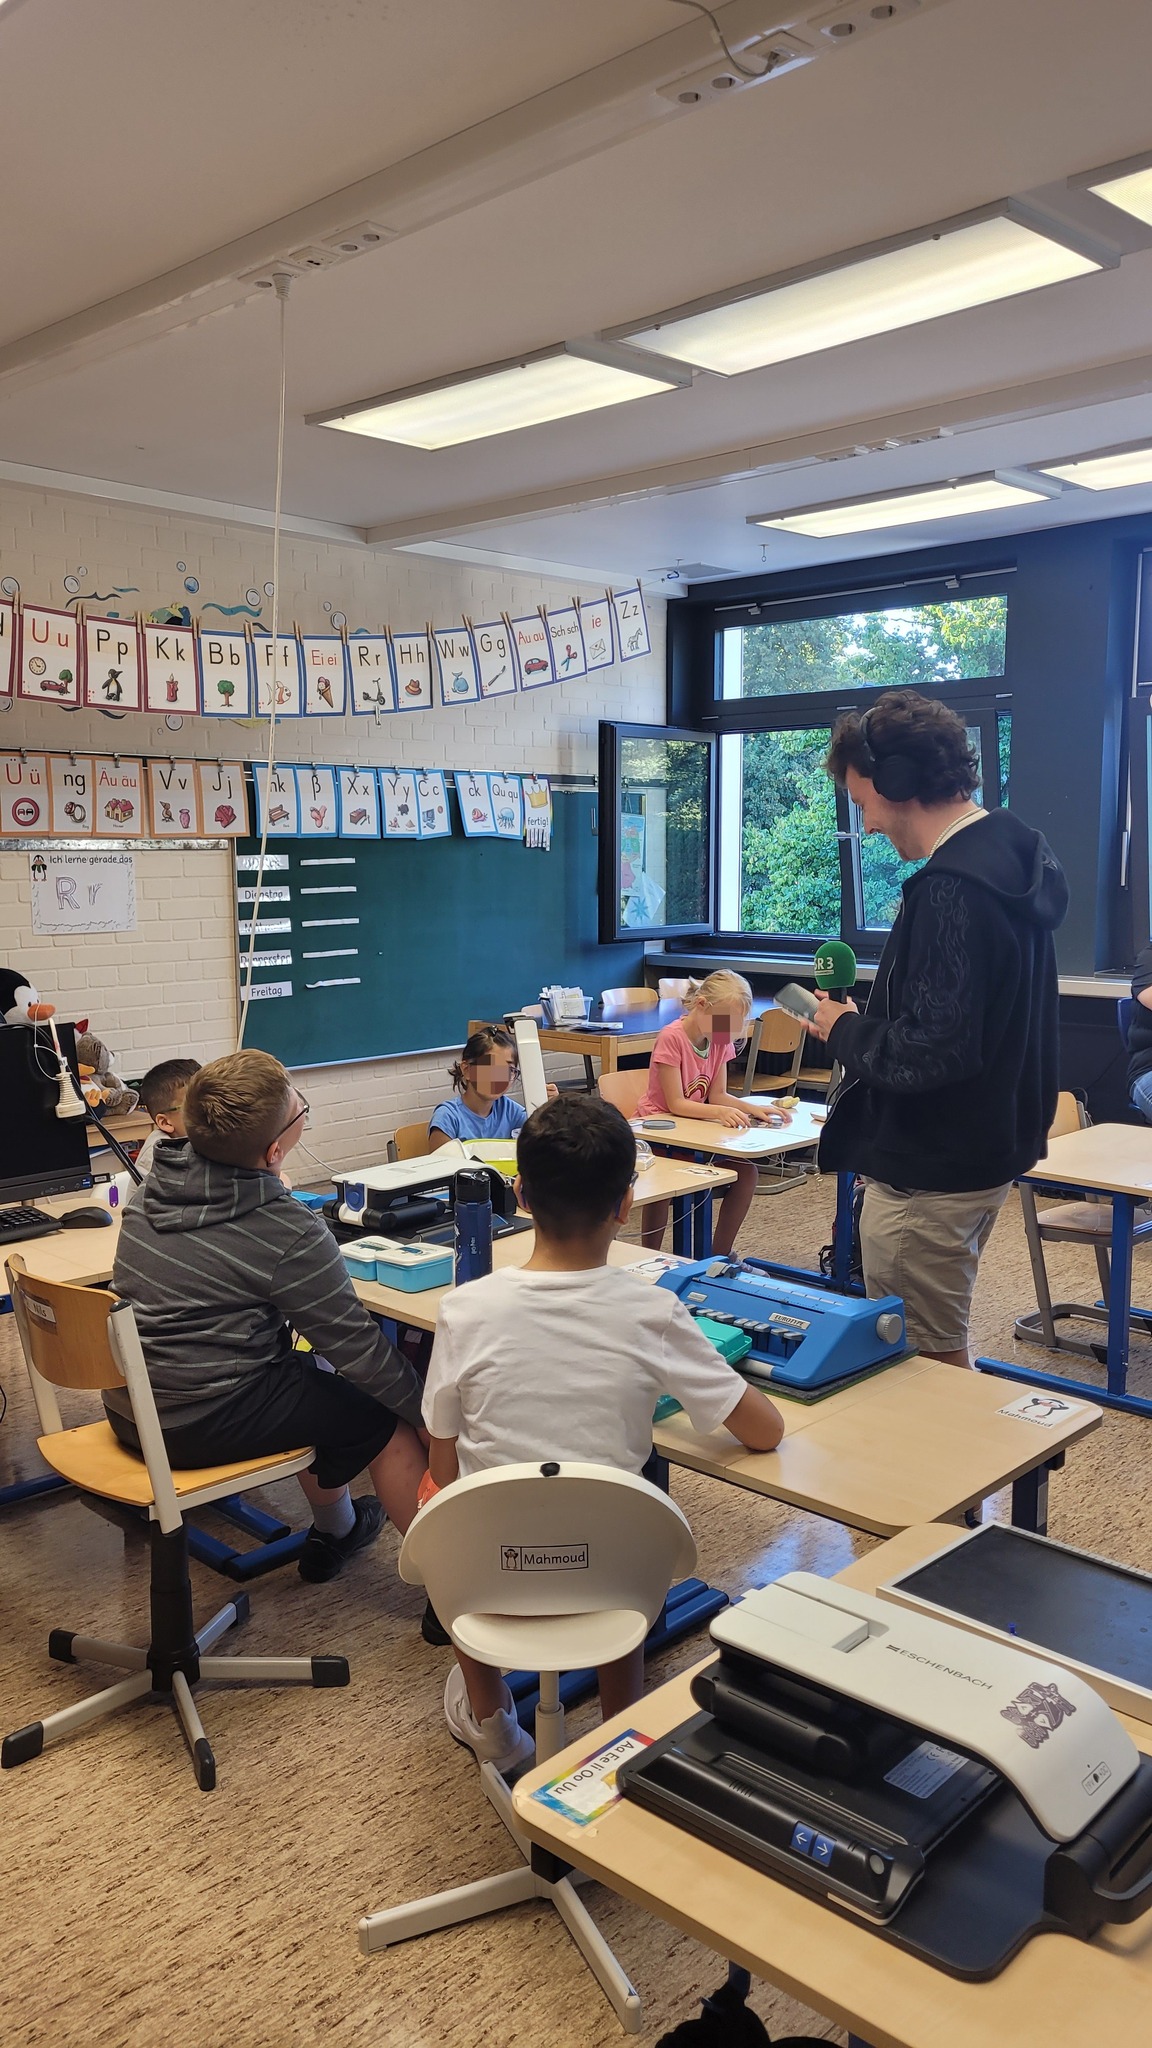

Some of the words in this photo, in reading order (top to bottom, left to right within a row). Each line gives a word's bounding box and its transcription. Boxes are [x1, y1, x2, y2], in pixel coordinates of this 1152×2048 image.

[591, 615, 602, 629] ie
[518, 631, 531, 645] Au
[534, 632, 545, 641] au
[551, 624, 566, 638] Sch
[311, 650, 324, 665] Ei
[99, 767, 118, 786] Äu
[121, 775, 137, 788] äu
[63, 774, 85, 796] ng
[468, 781, 481, 797] ck
[492, 784, 505, 797] Qu
[508, 792, 519, 803] qu
[527, 817, 549, 827] fertig!
[49, 855, 63, 864] Ich
[65, 855, 87, 864] lerne
[89, 855, 117, 865] gerade
[119, 854, 133, 864] das
[56, 876, 80, 910] R
[826, 957, 834, 970] 3
[251, 986, 283, 997] Freitag
[774, 1314, 805, 1326] EUROTYPE
[998, 1409, 1054, 1428] Mahmoud
[524, 1551, 586, 1565] Mahmoud
[900, 1649, 993, 1690] ESCHENBACH
[615, 1741, 635, 1754] Aa
[600, 1752, 620, 1764] Ee
[573, 1769, 594, 1782] Oo
[554, 1781, 578, 1795] Uu
